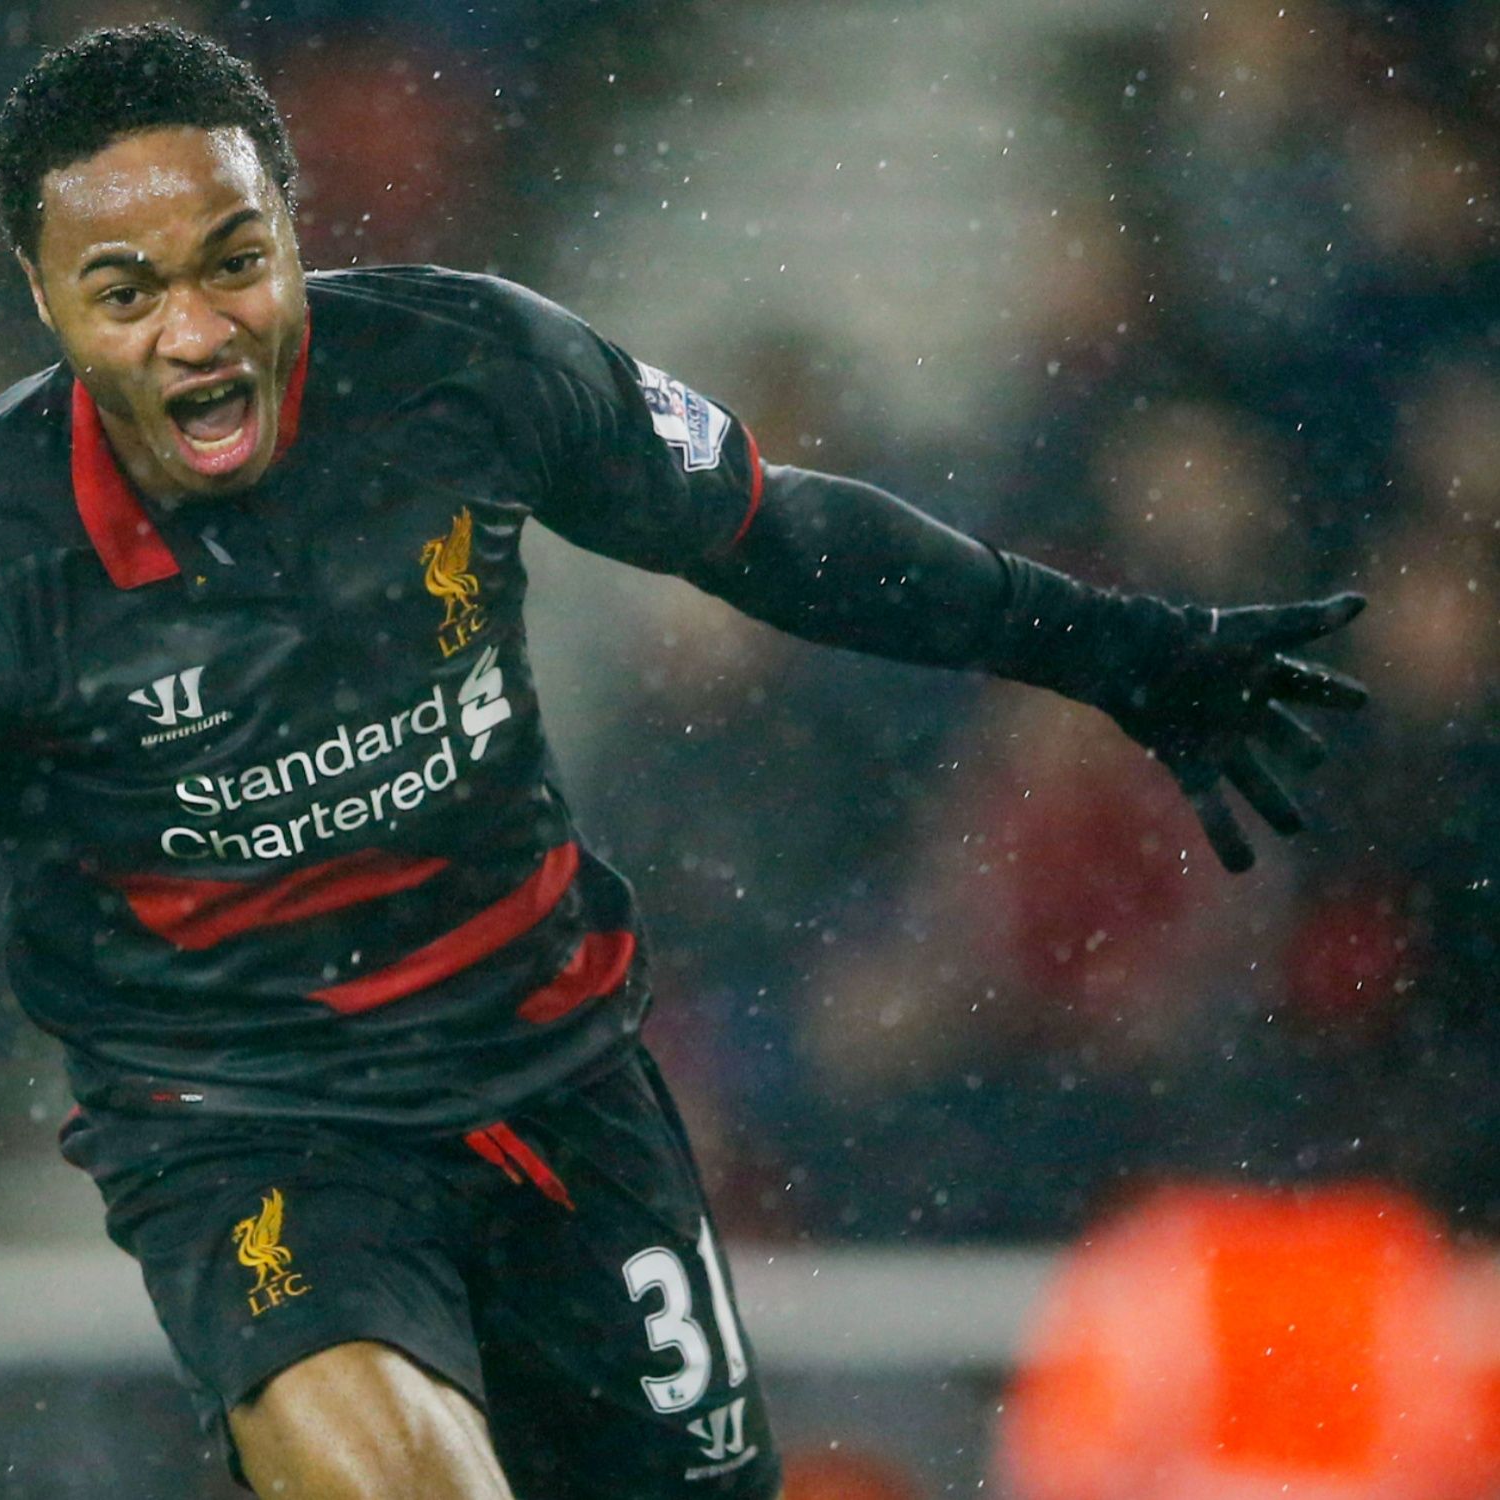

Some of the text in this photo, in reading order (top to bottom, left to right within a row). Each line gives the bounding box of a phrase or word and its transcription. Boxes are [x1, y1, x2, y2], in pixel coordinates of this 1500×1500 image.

[161, 737, 458, 861] Chartered
[176, 685, 448, 816] Standard
[622, 1216, 748, 1413] 31
